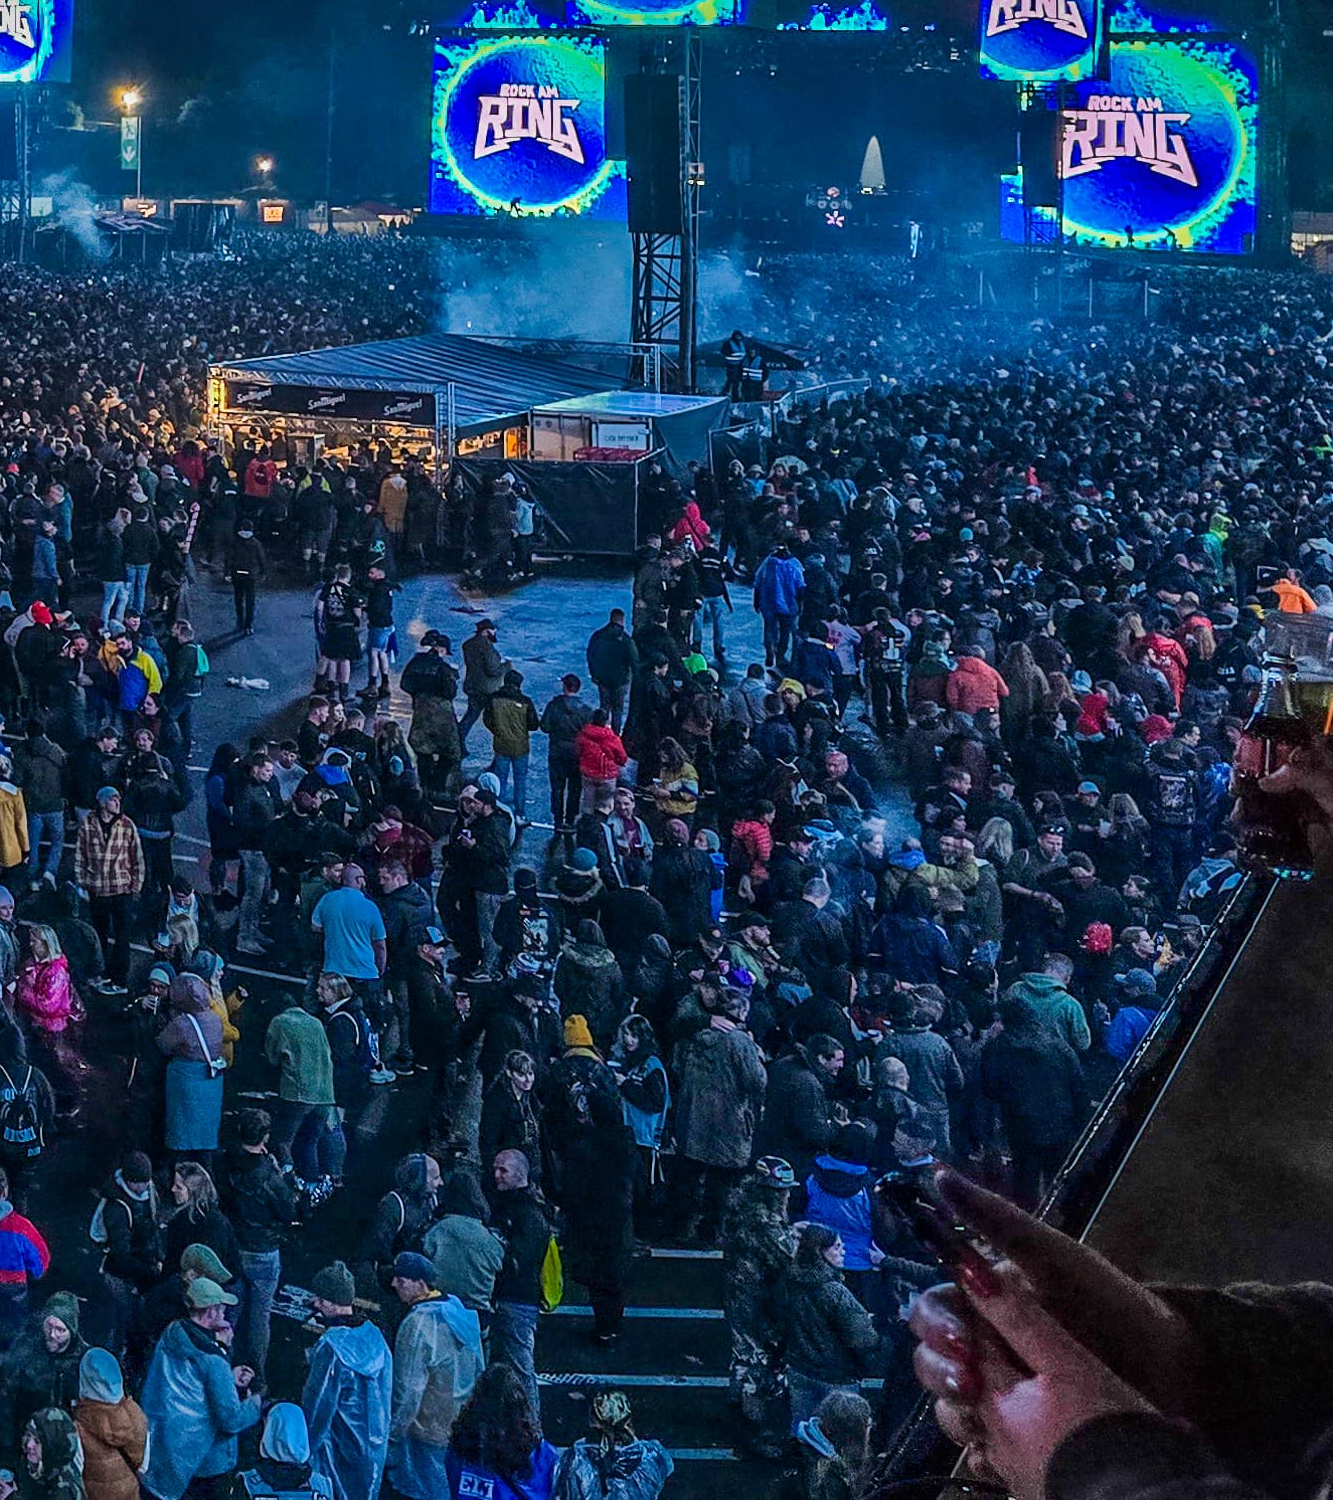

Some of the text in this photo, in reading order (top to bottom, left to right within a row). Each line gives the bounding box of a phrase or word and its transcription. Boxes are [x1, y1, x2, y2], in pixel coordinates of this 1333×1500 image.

[499, 83, 559, 98] ROCK AM
[1088, 95, 1164, 112] ROCK AM
[473, 96, 585, 165] RING
[1062, 110, 1198, 187] RING
